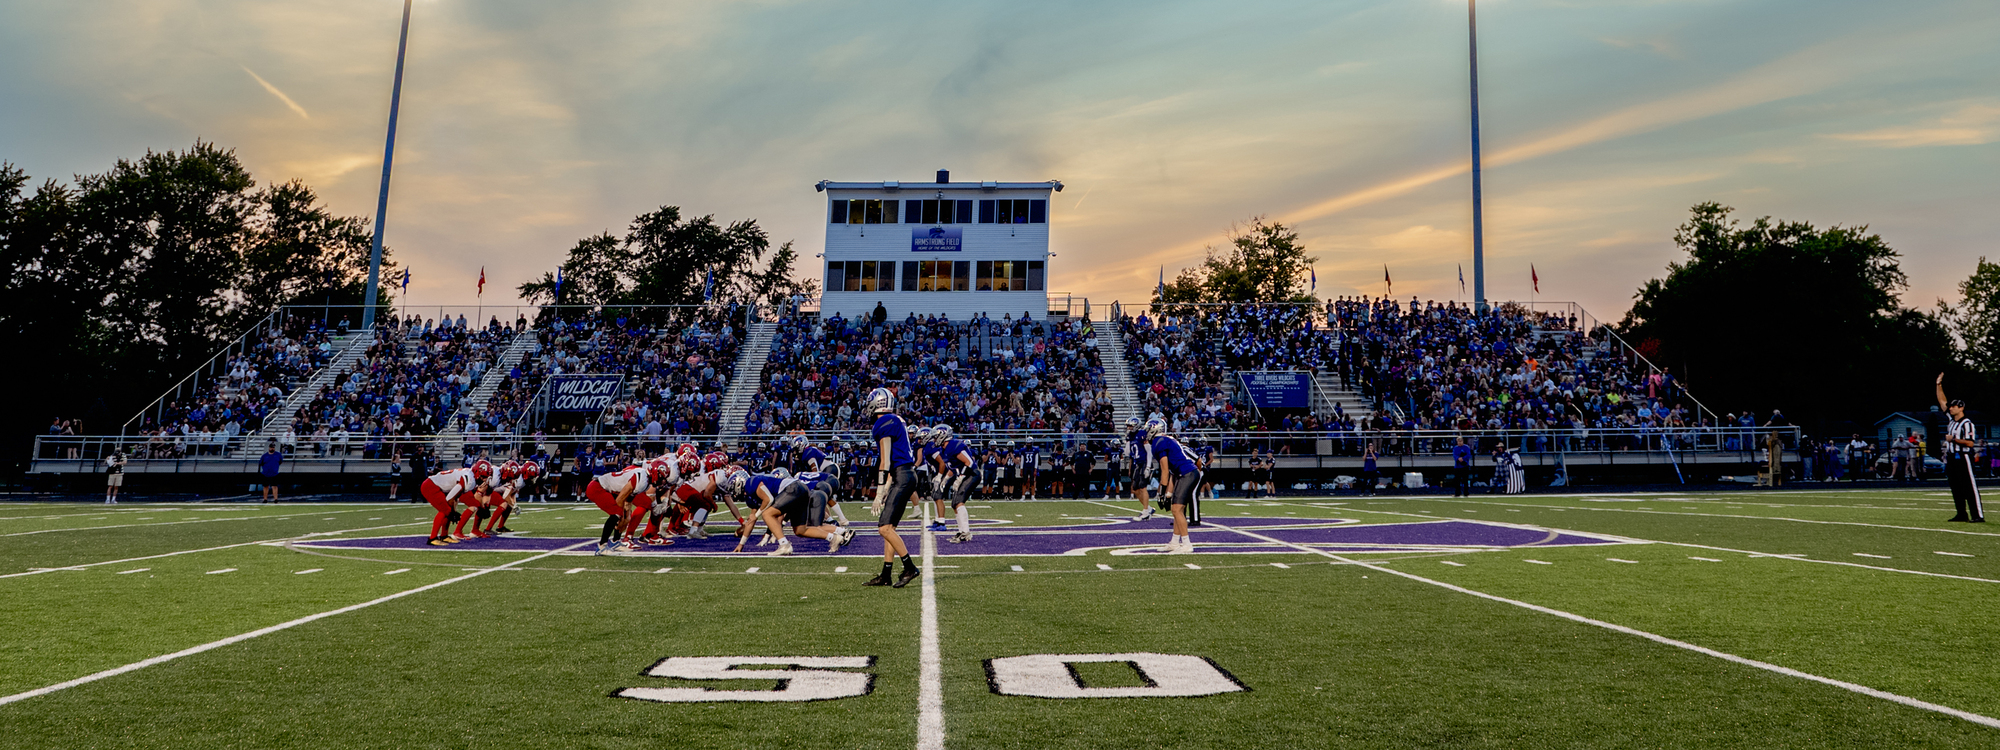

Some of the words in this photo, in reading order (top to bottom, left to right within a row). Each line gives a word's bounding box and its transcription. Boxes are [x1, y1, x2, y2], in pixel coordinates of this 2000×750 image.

[914, 238, 945, 246] ARMSTRONG
[946, 238, 960, 246] FIELD
[558, 380, 617, 394] WILDCAT
[555, 395, 612, 409] COUNTR
[585, 459, 591, 467] 3
[1025, 453, 1033, 463] 55
